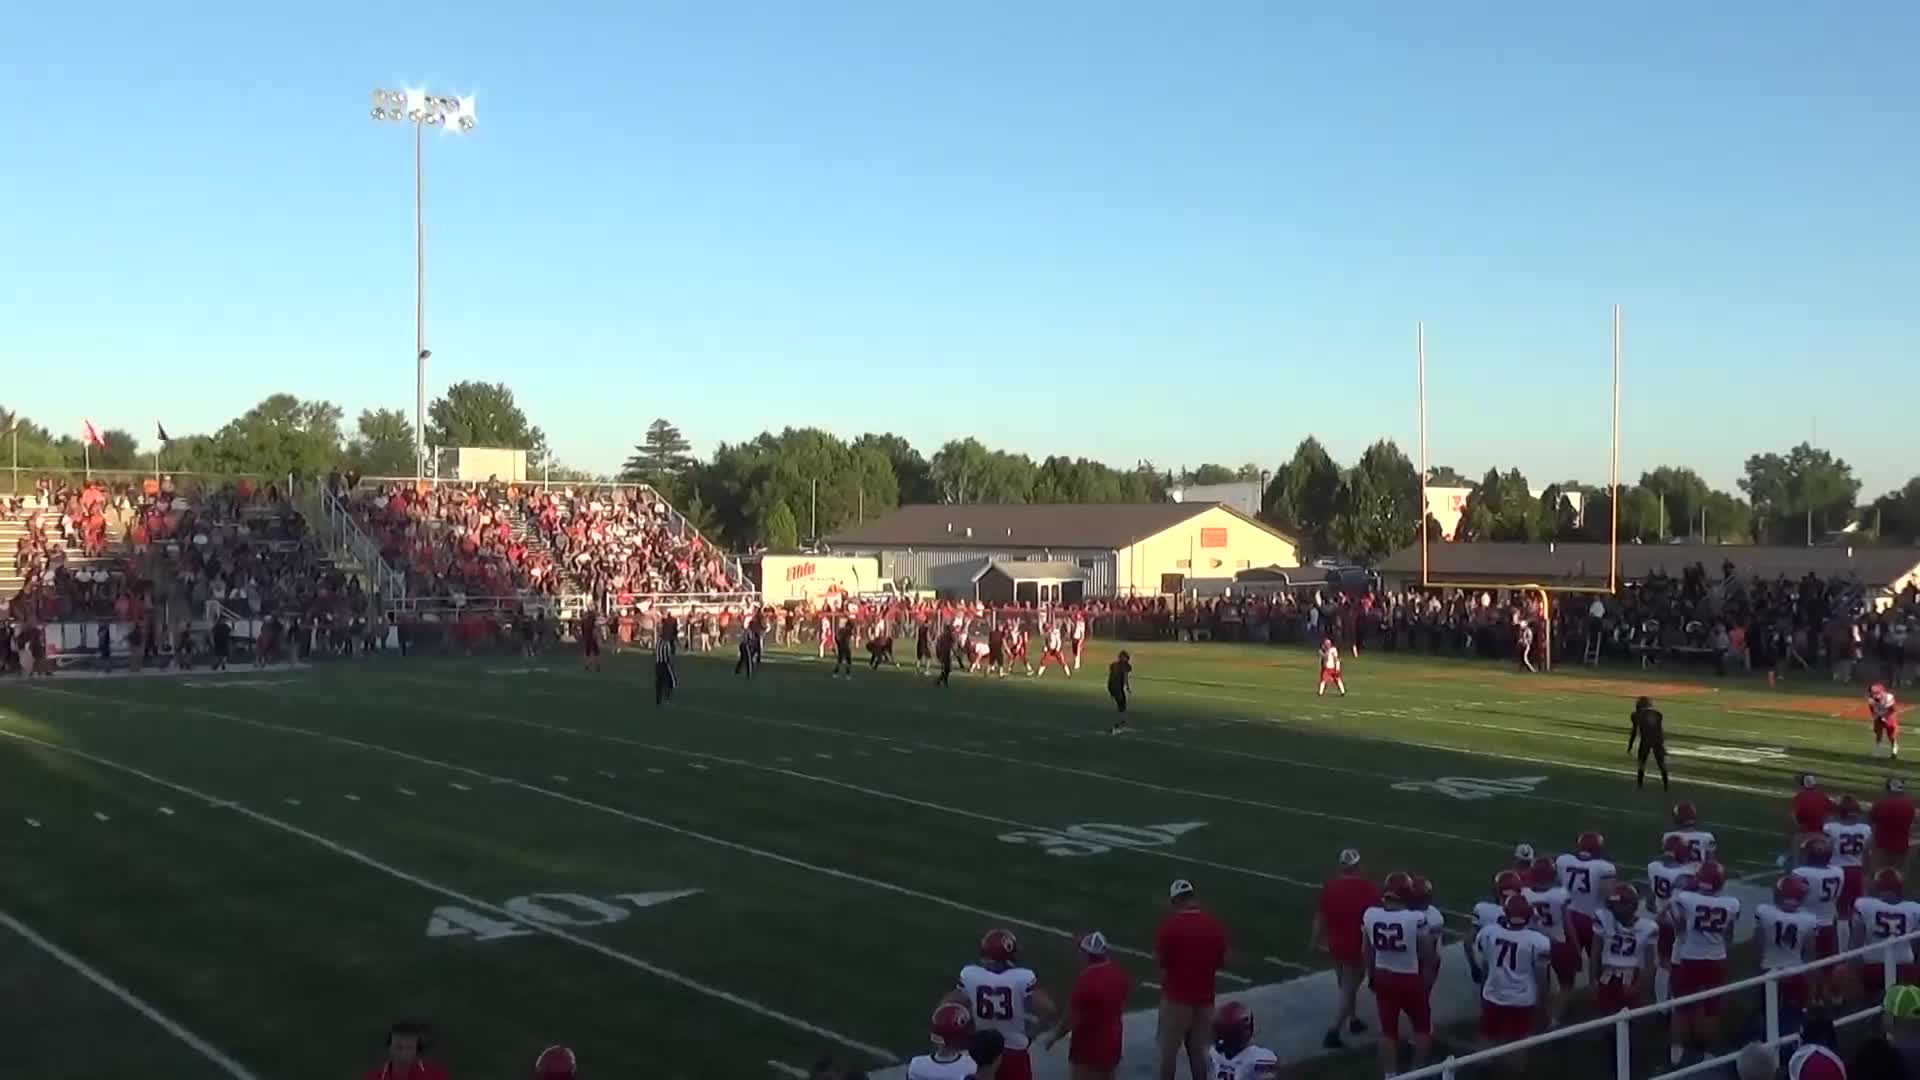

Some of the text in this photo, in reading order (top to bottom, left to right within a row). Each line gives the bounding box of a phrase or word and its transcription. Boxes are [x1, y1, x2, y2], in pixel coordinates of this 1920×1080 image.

[997, 823, 1176, 856] 30
[1839, 833, 1864, 855] 26
[1566, 866, 1591, 893] 73
[426, 892, 631, 941] 40
[1695, 905, 1727, 932] 22
[1874, 911, 1906, 938] 53
[1373, 921, 1407, 951] 62
[1775, 920, 1798, 948] 14
[1496, 938, 1518, 970] 71
[976, 985, 1013, 1019] 63
